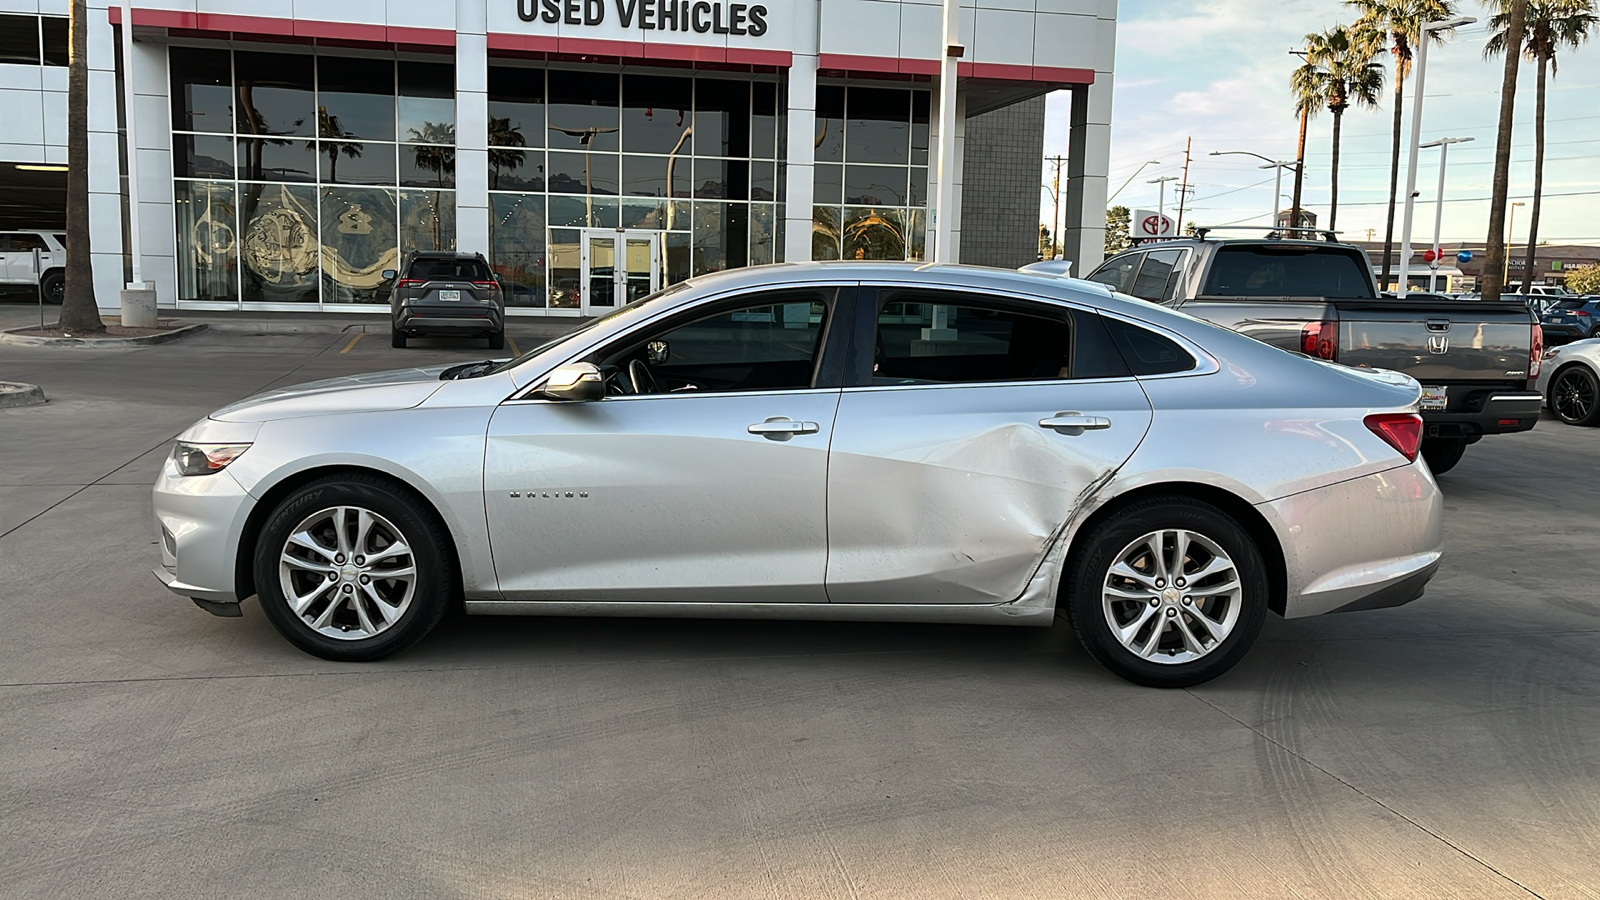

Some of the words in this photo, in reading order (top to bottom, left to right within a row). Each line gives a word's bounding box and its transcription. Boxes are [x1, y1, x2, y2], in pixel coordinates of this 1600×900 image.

[517, 0, 605, 25] USED
[617, 0, 768, 37] VEHICLES
[269, 489, 325, 534] SENTURY
[509, 491, 589, 499] MALIBU
